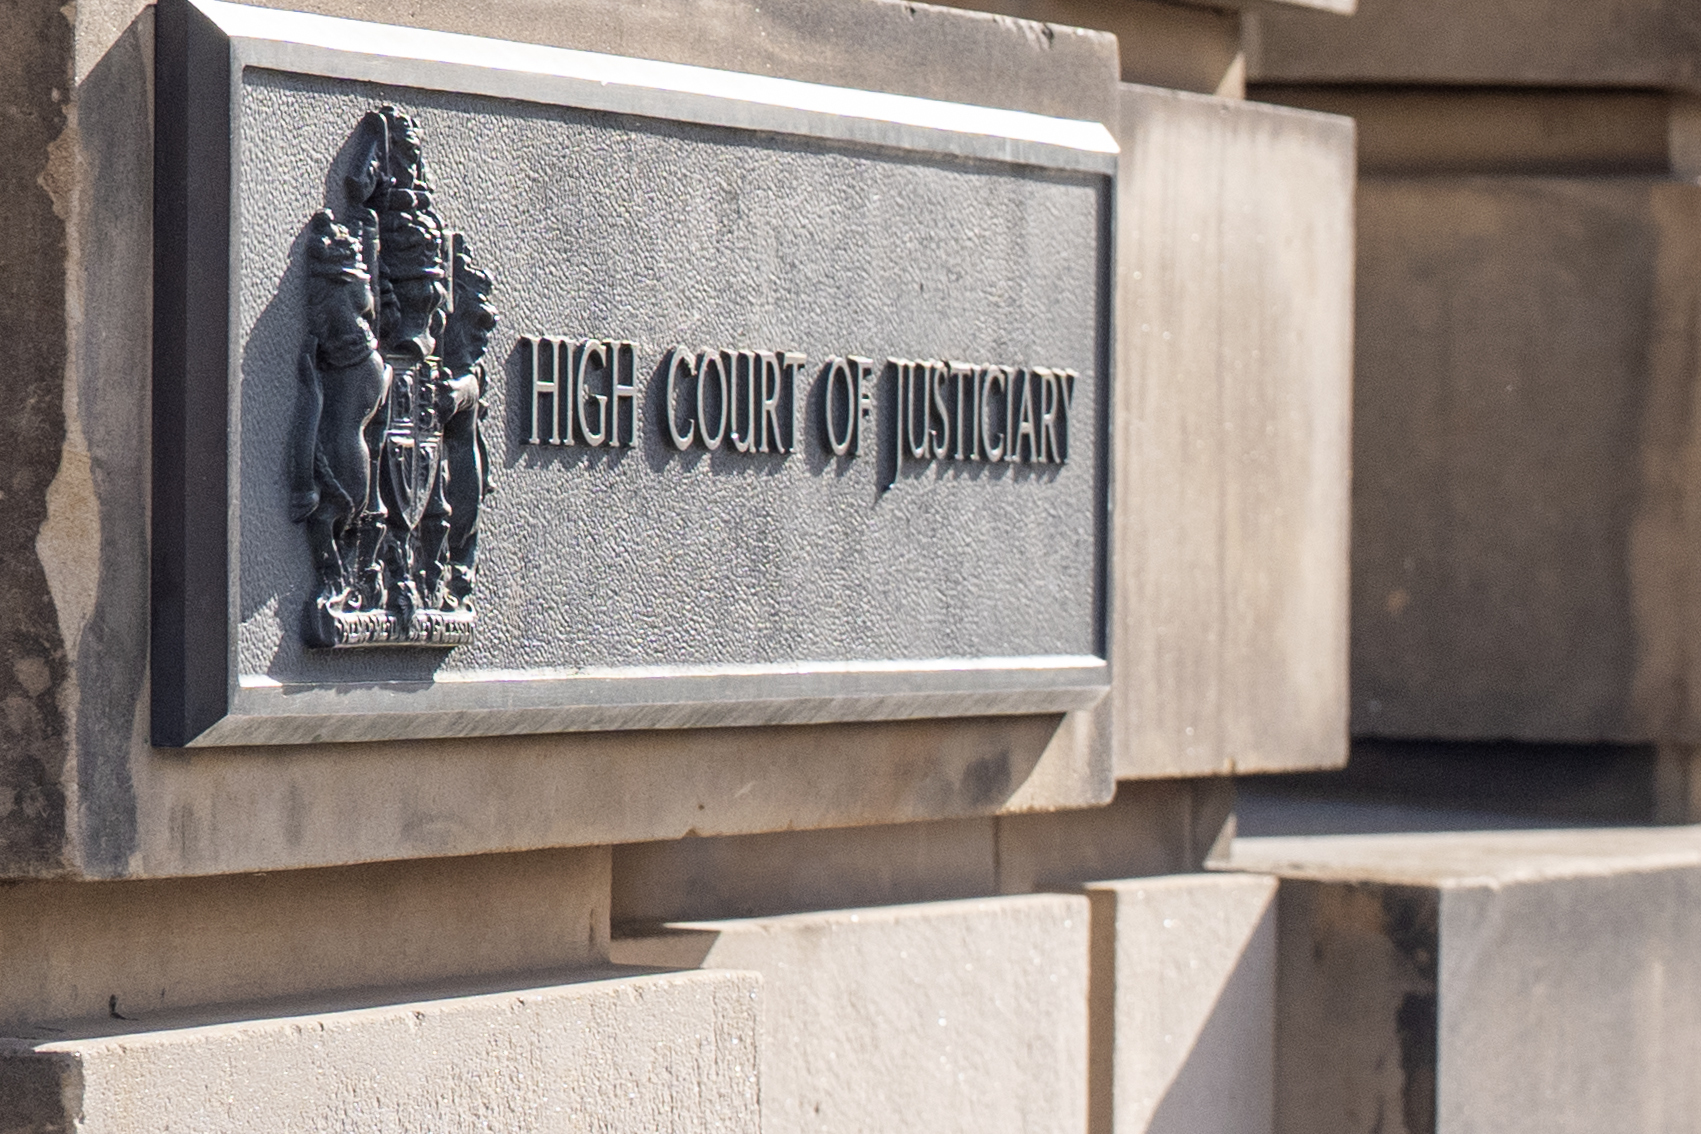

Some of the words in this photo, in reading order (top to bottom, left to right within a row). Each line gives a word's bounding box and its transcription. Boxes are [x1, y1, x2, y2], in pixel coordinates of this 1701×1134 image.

[522, 336, 639, 448] HIGH
[667, 346, 808, 454] COURT
[826, 355, 874, 456] OF
[884, 356, 1079, 491] JUSTICIARY
